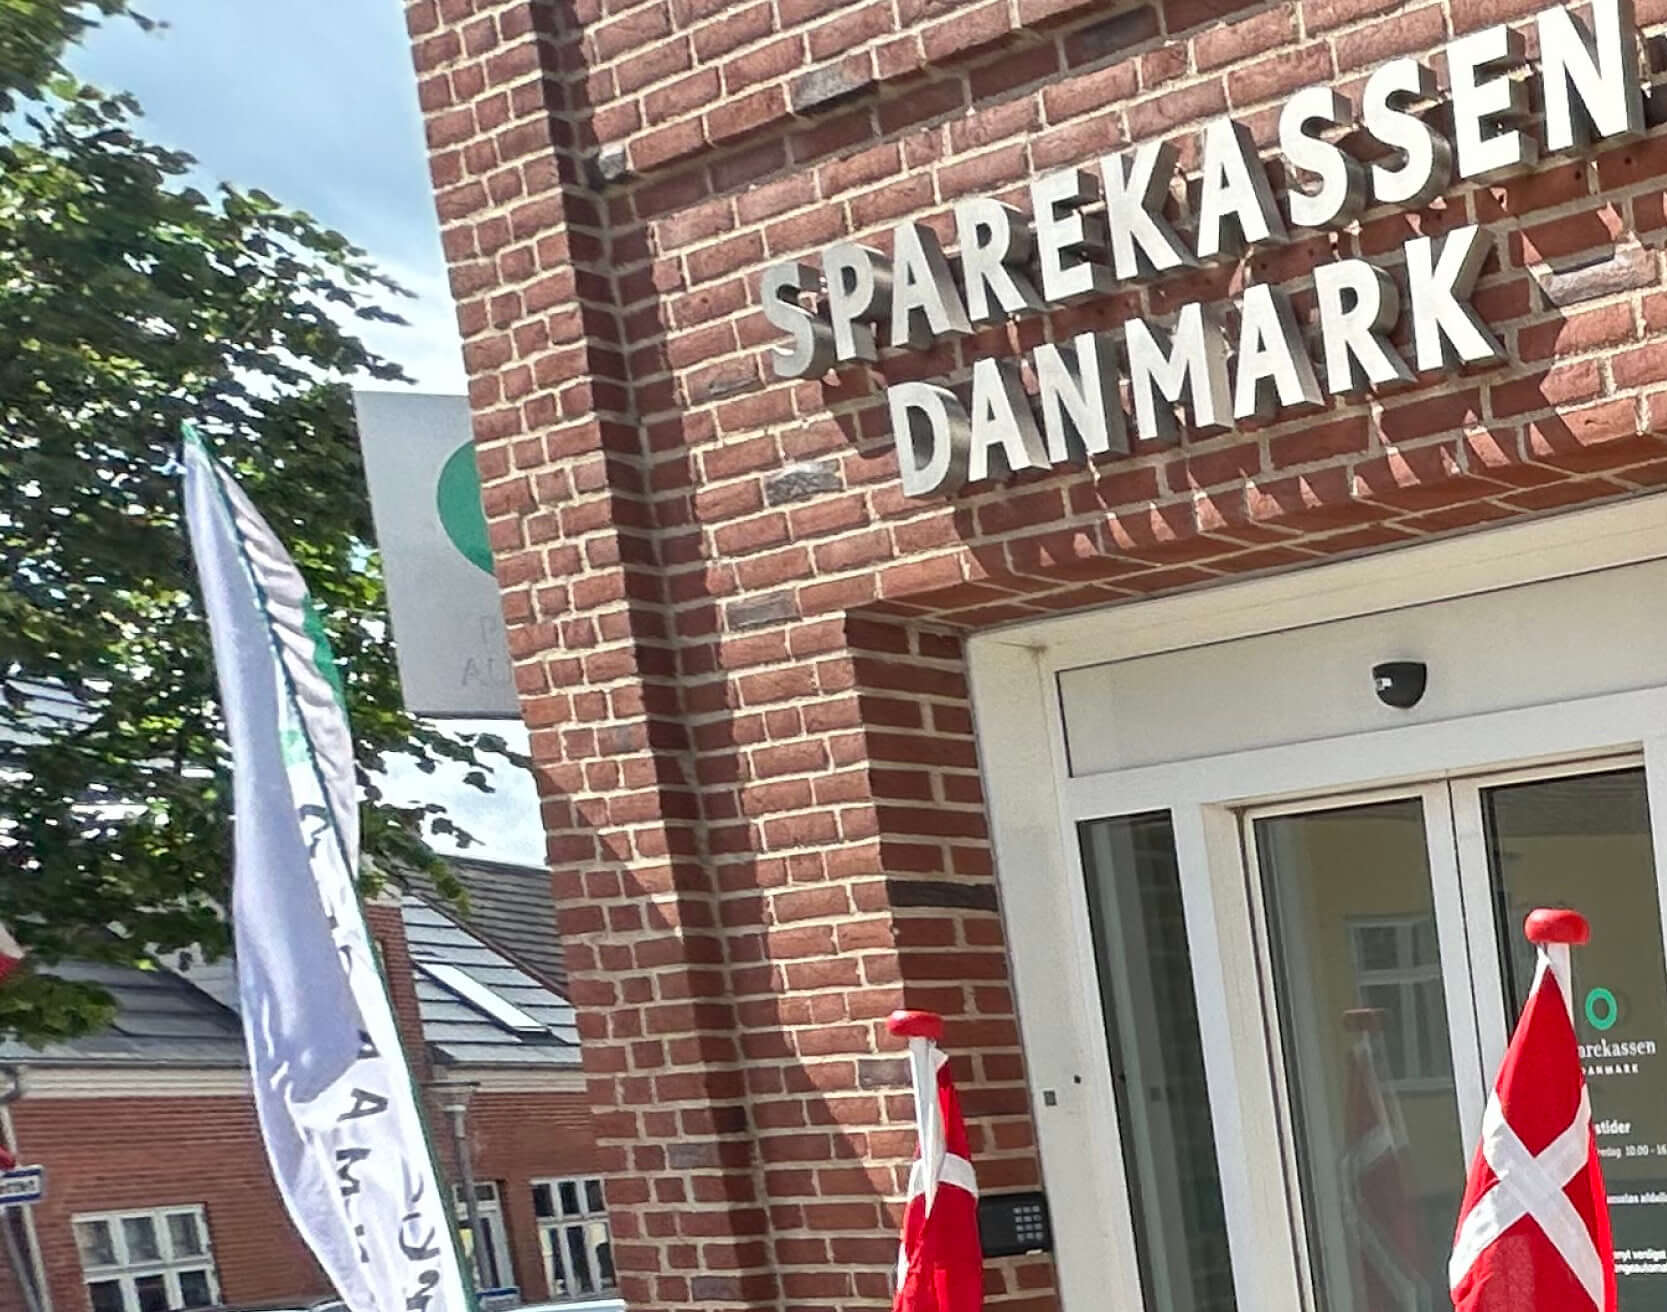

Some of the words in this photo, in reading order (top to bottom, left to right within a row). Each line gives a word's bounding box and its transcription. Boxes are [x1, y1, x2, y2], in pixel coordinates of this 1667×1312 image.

[761, 0, 1646, 379] SPAREKASSEN
[887, 224, 1510, 498] DANMARK
[1577, 1039, 1656, 1058] arekassen
